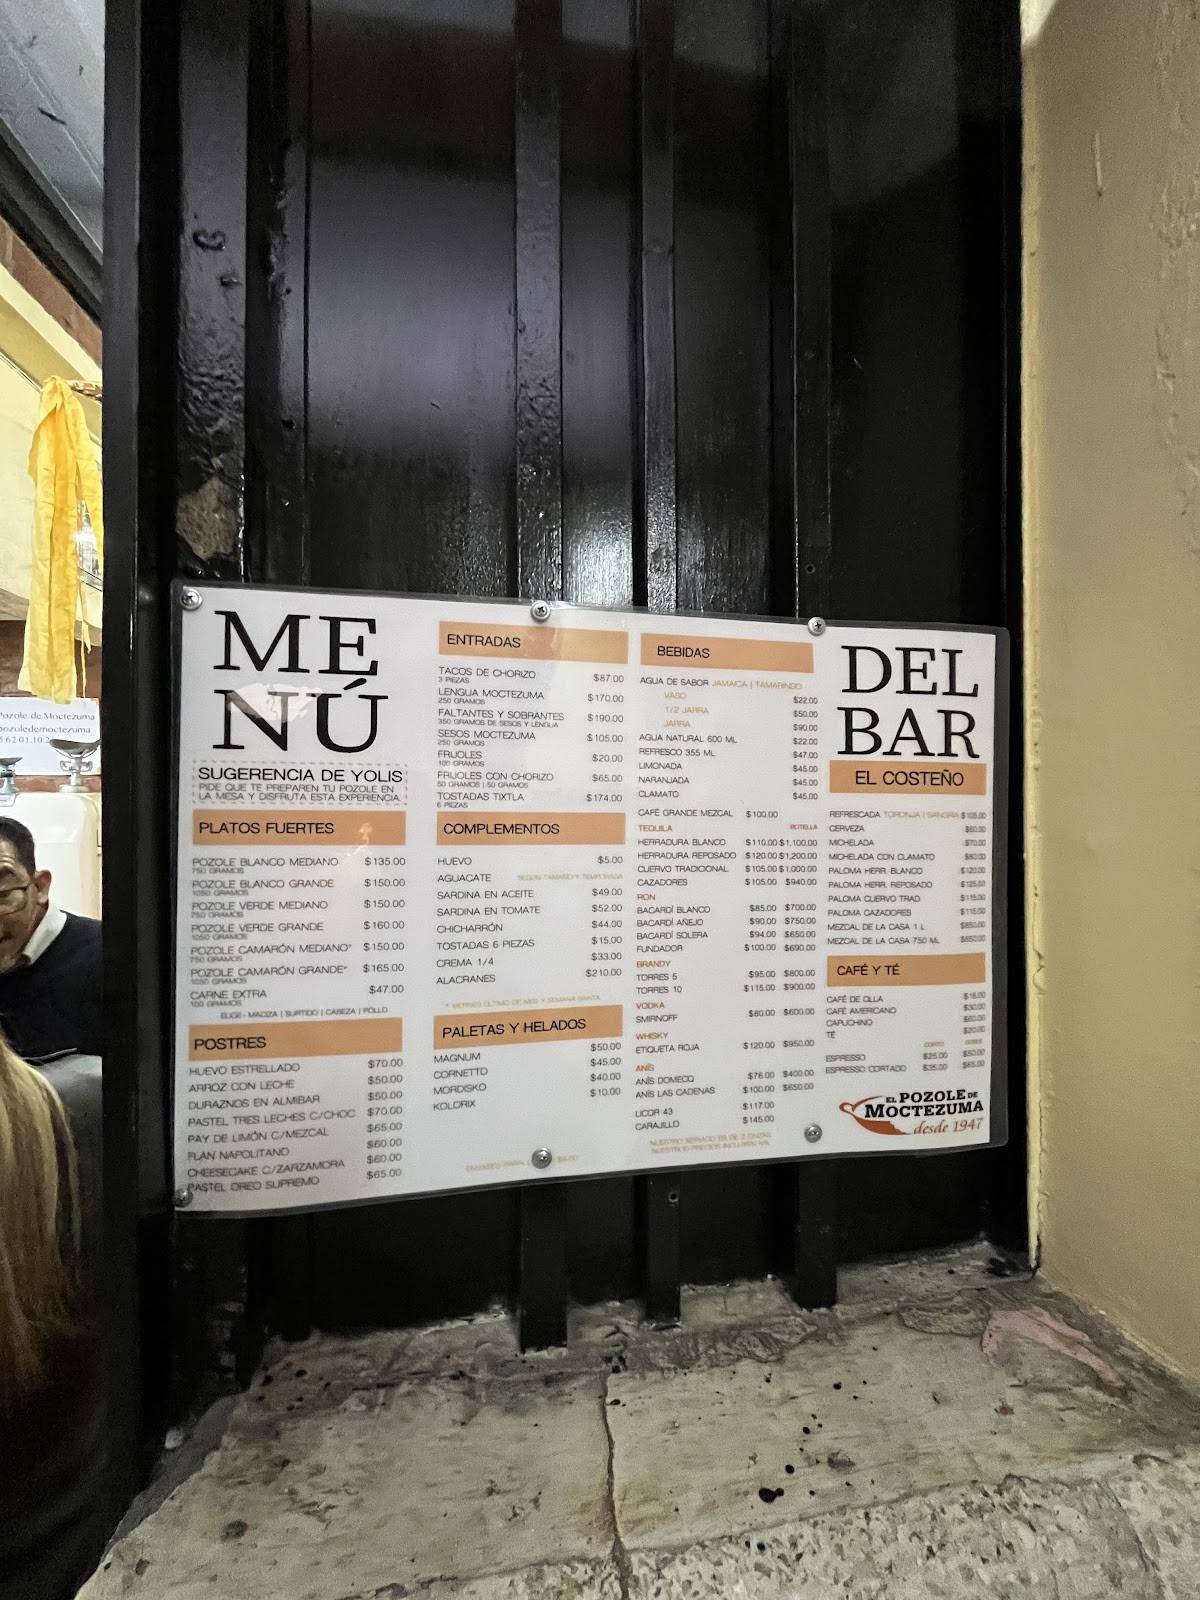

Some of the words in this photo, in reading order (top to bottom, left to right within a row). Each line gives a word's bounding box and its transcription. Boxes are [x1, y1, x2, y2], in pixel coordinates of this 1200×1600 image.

[214, 611, 378, 675] ME
[448, 634, 520, 648] ENTRADAS
[658, 646, 710, 658] BEBIDAS
[439, 667, 472, 676] TACOS
[493, 669, 536, 678] CHORIZO
[841, 645, 978, 697] DEL
[593, 674, 624, 683] $87.00
[640, 677, 663, 685] AGUA
[681, 678, 708, 686] SABOR
[439, 688, 478, 697] LENGUA
[483, 690, 544, 699] MOCTEZUMA
[31, 712, 40, 720] de
[44, 712, 95, 721] Moctezuma
[213, 678, 388, 753] NÚ
[439, 709, 493, 718] FALTANTES
[508, 711, 564, 720] SOBRANTES
[438, 730, 470, 738] SESOS
[474, 731, 535, 739] MOCTEZUMA
[837, 707, 979, 758] BAR
[592, 754, 623, 762] $20.00
[199, 768, 314, 781] SUGERENCIA
[322, 770, 344, 781] DE
[351, 770, 402, 782] YOLIS
[592, 774, 622, 782] $65.00
[856, 771, 876, 785] EL
[883, 769, 963, 786] COSTEÑO
[266, 784, 318, 792] PREPAREN
[381, 785, 394, 793] EN
[200, 822, 260, 834] PLATOS
[266, 823, 334, 834] FUERTES
[444, 823, 559, 834] COMPLEMENTOS
[638, 838, 688, 846] HERRADURA
[192, 858, 236, 867] POZOLE
[240, 858, 285, 866] BLANCO
[290, 858, 338, 866] MEDIANO
[438, 857, 472, 865] HUEVO
[598, 856, 623, 864] $5.00
[438, 874, 491, 882] AGUACATE
[437, 891, 480, 900] SARDINA
[502, 890, 534, 898] ACEITE
[592, 888, 622, 896] $49.00
[192, 901, 235, 910] POZOLE
[239, 901, 274, 910] VERDE
[279, 901, 328, 909] MEDIANO
[592, 904, 622, 912] $52.00
[437, 924, 503, 933] CHICHARRÓN
[592, 920, 622, 928] $44.00
[437, 941, 489, 950] TOSTADAS
[503, 940, 534, 948] PIEZAS
[437, 959, 472, 968] CREMA
[478, 958, 493, 966] 1/4
[837, 963, 868, 976] CAFÉ
[873, 966, 880, 975] Y
[885, 963, 900, 975] TÉ
[436, 975, 495, 984] ALACRANES
[369, 985, 404, 994] $47.00
[190, 991, 228, 1000] CARNE
[233, 990, 267, 999] EXTRA
[443, 1024, 504, 1038] PALETAS
[510, 1023, 519, 1033] Y
[524, 1019, 586, 1032] HELADOS
[194, 1037, 266, 1050] POSTRES
[591, 1043, 621, 1052] $50.00
[434, 1053, 480, 1063] MAGNUM
[591, 1058, 621, 1066] $45.00
[189, 1066, 227, 1075] HUEVO
[232, 1063, 300, 1074] ESTRELLADO
[368, 1059, 403, 1069] $70.00
[434, 1068, 488, 1079] CORNETTO
[368, 1075, 402, 1085] $50.00
[189, 1083, 227, 1092] ARROZ
[231, 1082, 255, 1091] CON
[260, 1080, 295, 1089] LECHE
[900, 1090, 965, 1102] POZOLE
[433, 1100, 476, 1111] KOLORIX
[865, 1101, 983, 1118] MOCTEZUMA
[367, 1107, 402, 1117] $70.00
[188, 1117, 228, 1127] PASTEL
[233, 1115, 259, 1124] TRES
[265, 1112, 305, 1123] LECHES
[914, 1121, 948, 1134] desde
[953, 1118, 983, 1132] 1947
[188, 1135, 208, 1143] PAY
[214, 1134, 228, 1143] DE
[232, 1131, 267, 1142] LIMÓN
[272, 1128, 328, 1139] C/MEZCAL
